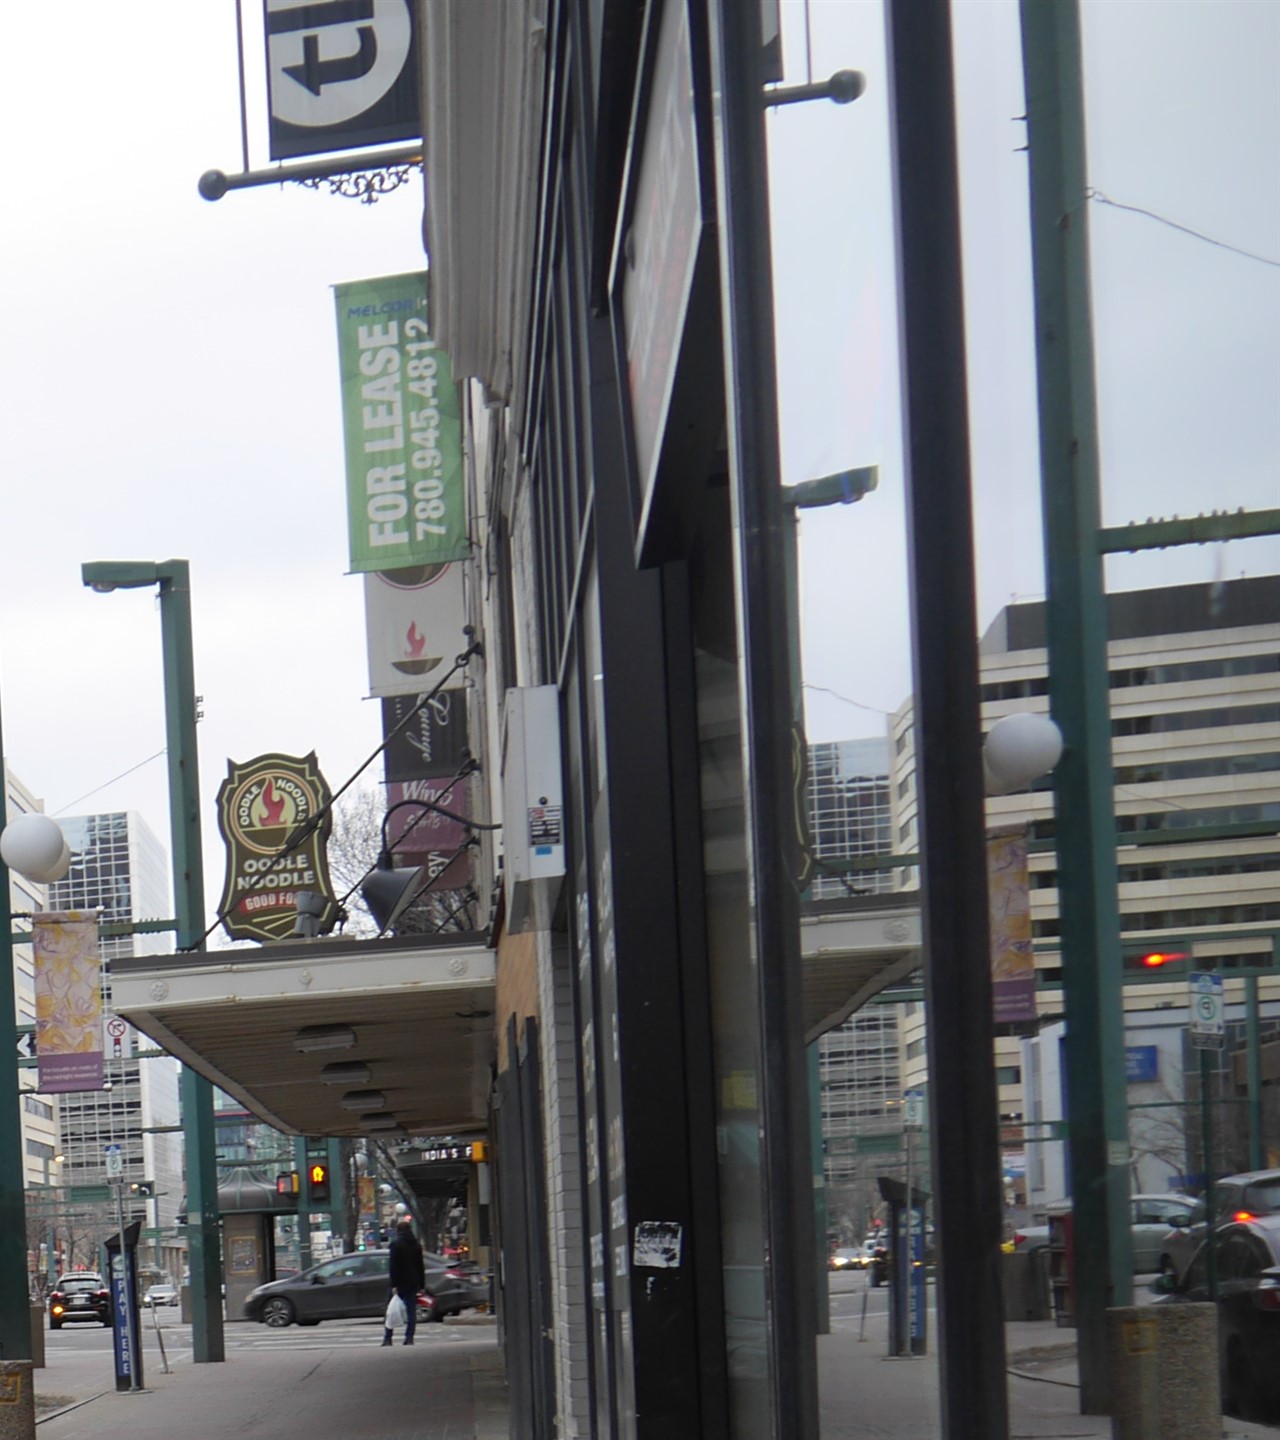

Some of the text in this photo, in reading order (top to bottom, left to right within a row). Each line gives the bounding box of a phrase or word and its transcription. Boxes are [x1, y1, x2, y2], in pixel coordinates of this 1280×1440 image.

[358, 320, 409, 547] FOR LEASE
[404, 317, 446, 542] 780.945.4812
[240, 784, 261, 826] OODLE
[237, 871, 316, 891] NOODLE
[243, 854, 309, 873] OODLE
[245, 890, 297, 911] GOOD FO
[118, 1279, 129, 1317] PAY
[121, 1328, 131, 1375] HERE
